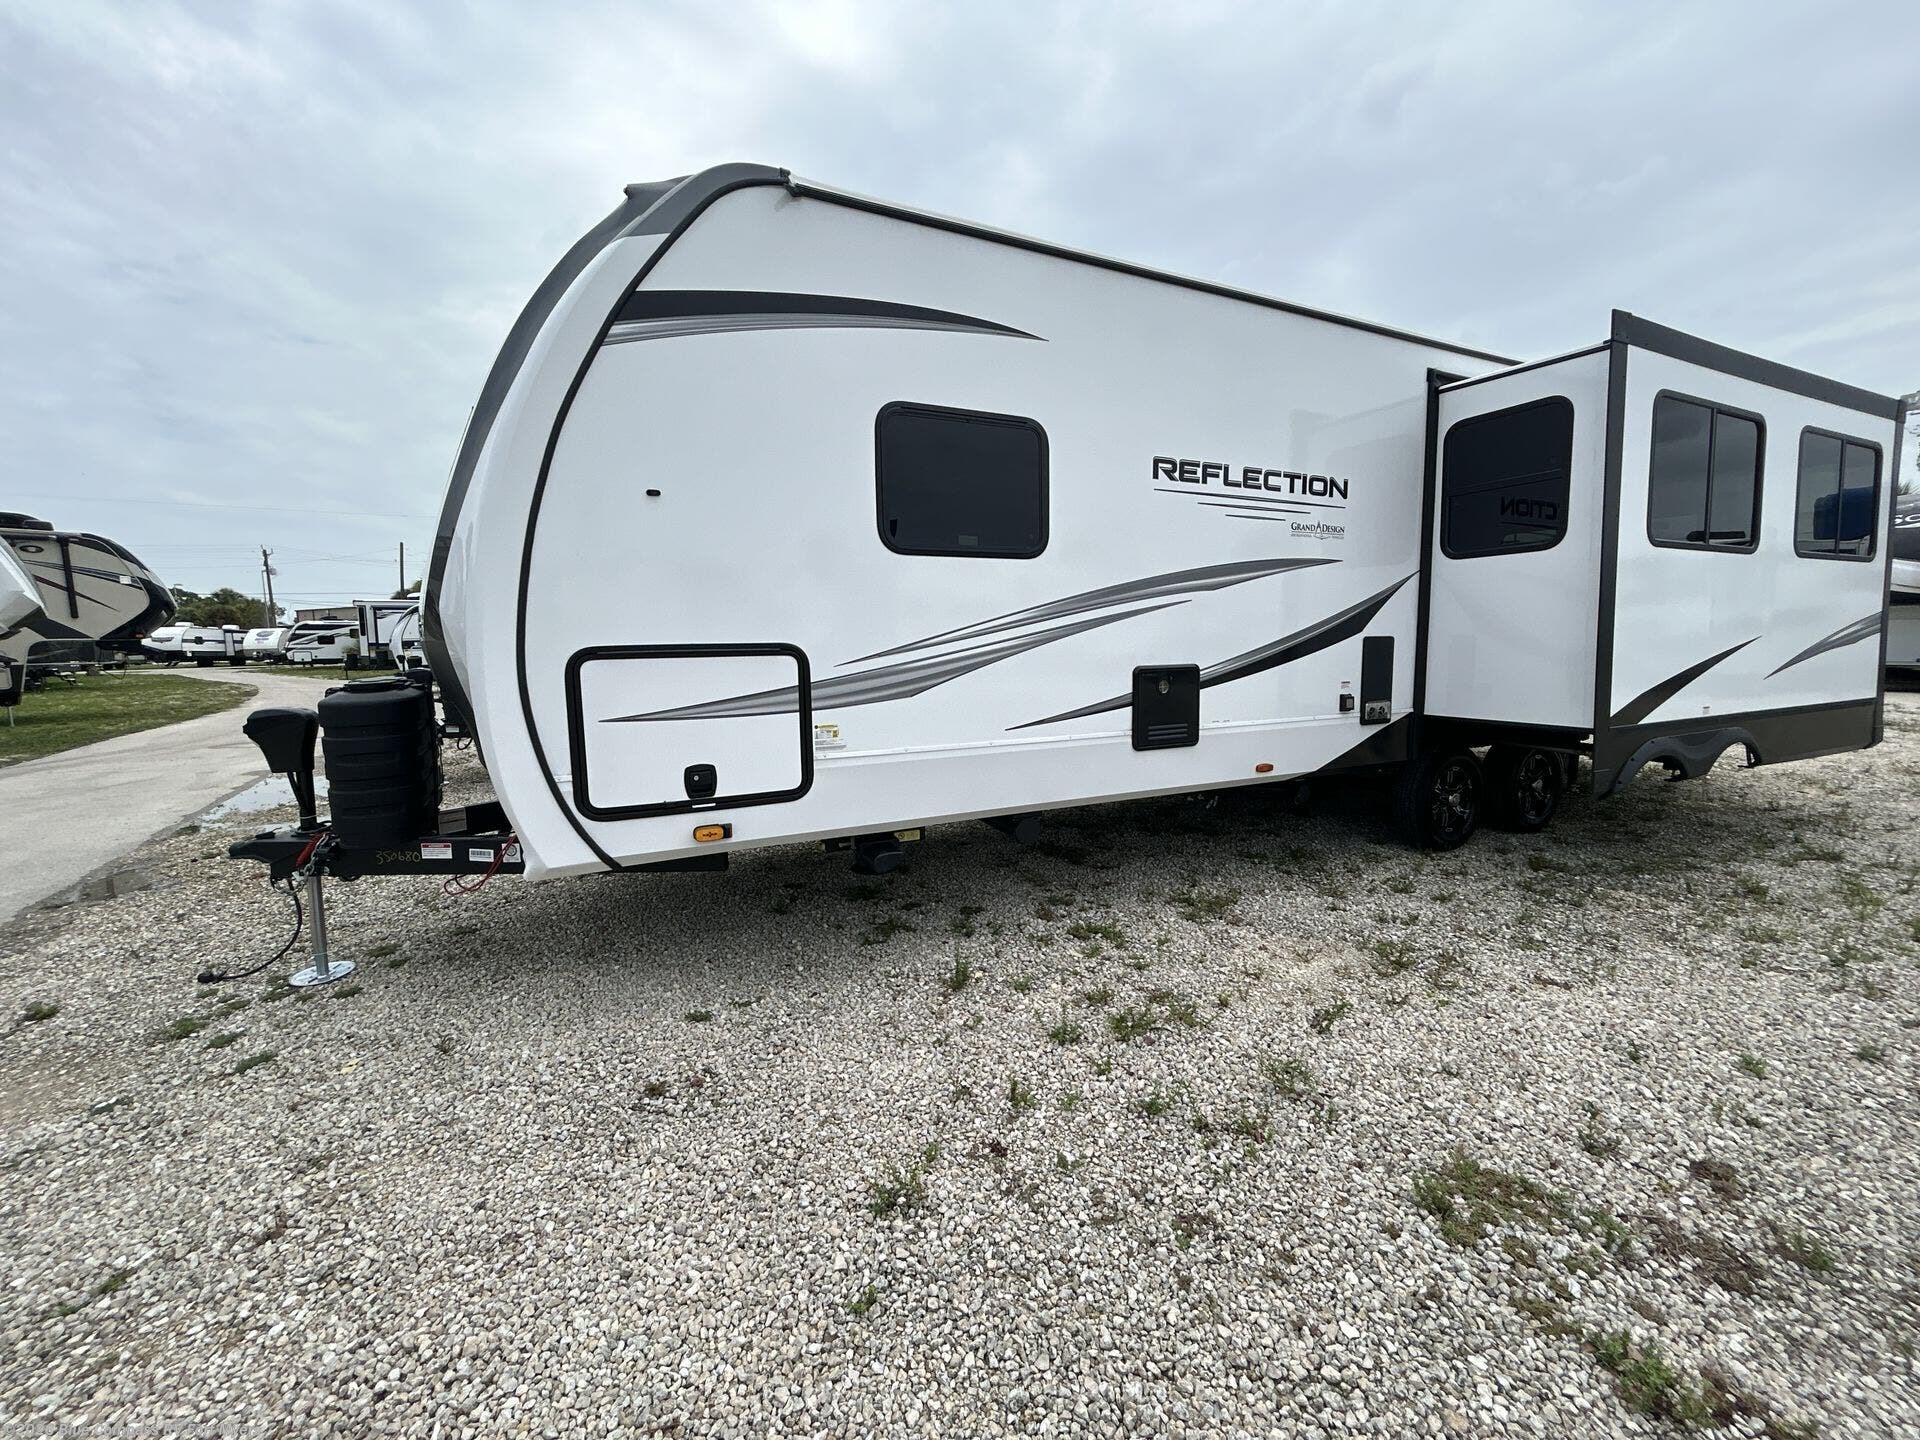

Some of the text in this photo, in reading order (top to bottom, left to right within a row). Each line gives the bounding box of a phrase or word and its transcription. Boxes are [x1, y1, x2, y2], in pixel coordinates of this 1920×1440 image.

[1152, 455, 1349, 500] REFLECTION
[1290, 521, 1345, 534] GRAND DESIGN
